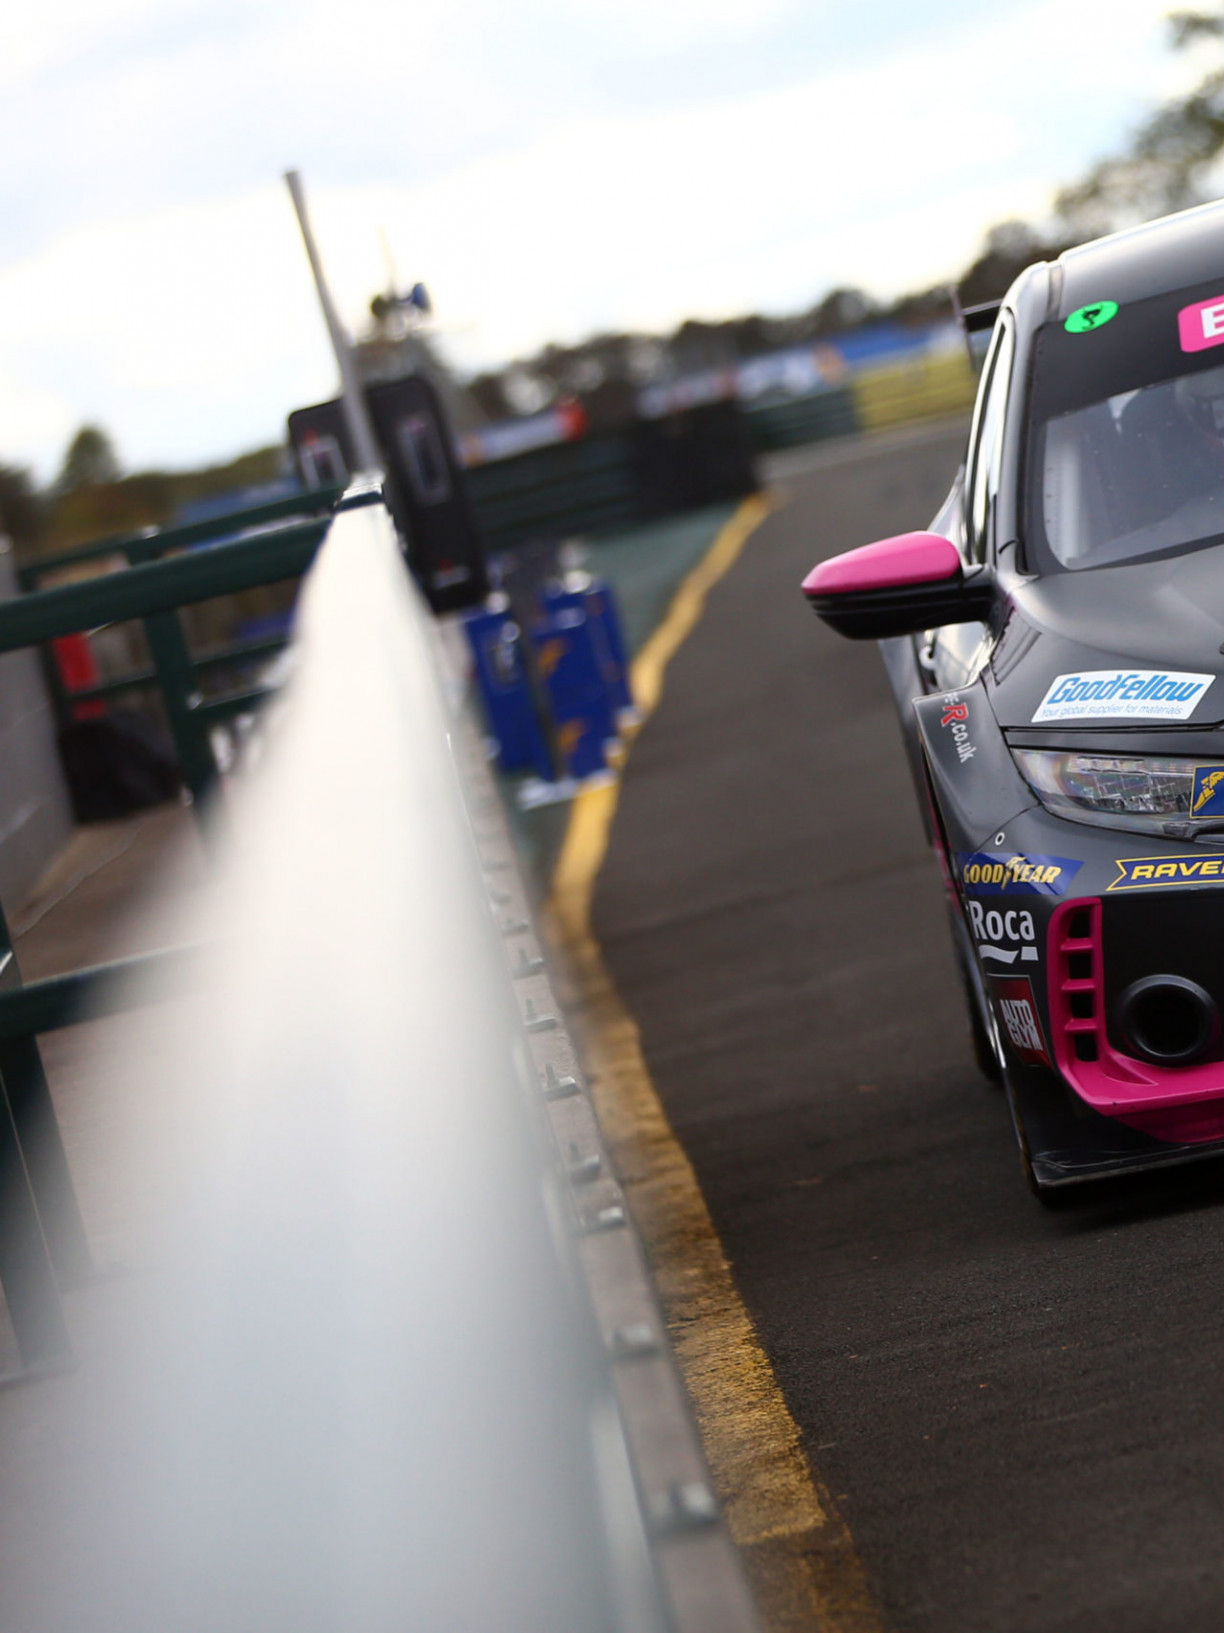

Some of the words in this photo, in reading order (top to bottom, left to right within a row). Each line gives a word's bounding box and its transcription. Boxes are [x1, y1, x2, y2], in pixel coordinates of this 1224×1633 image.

[1060, 704, 1088, 718] global
[1088, 704, 1124, 717] supplier
[1125, 703, 1138, 714] for
[1140, 704, 1184, 716] materials
[963, 861, 1062, 886] GOODYEAR
[969, 900, 1035, 941] Roca
